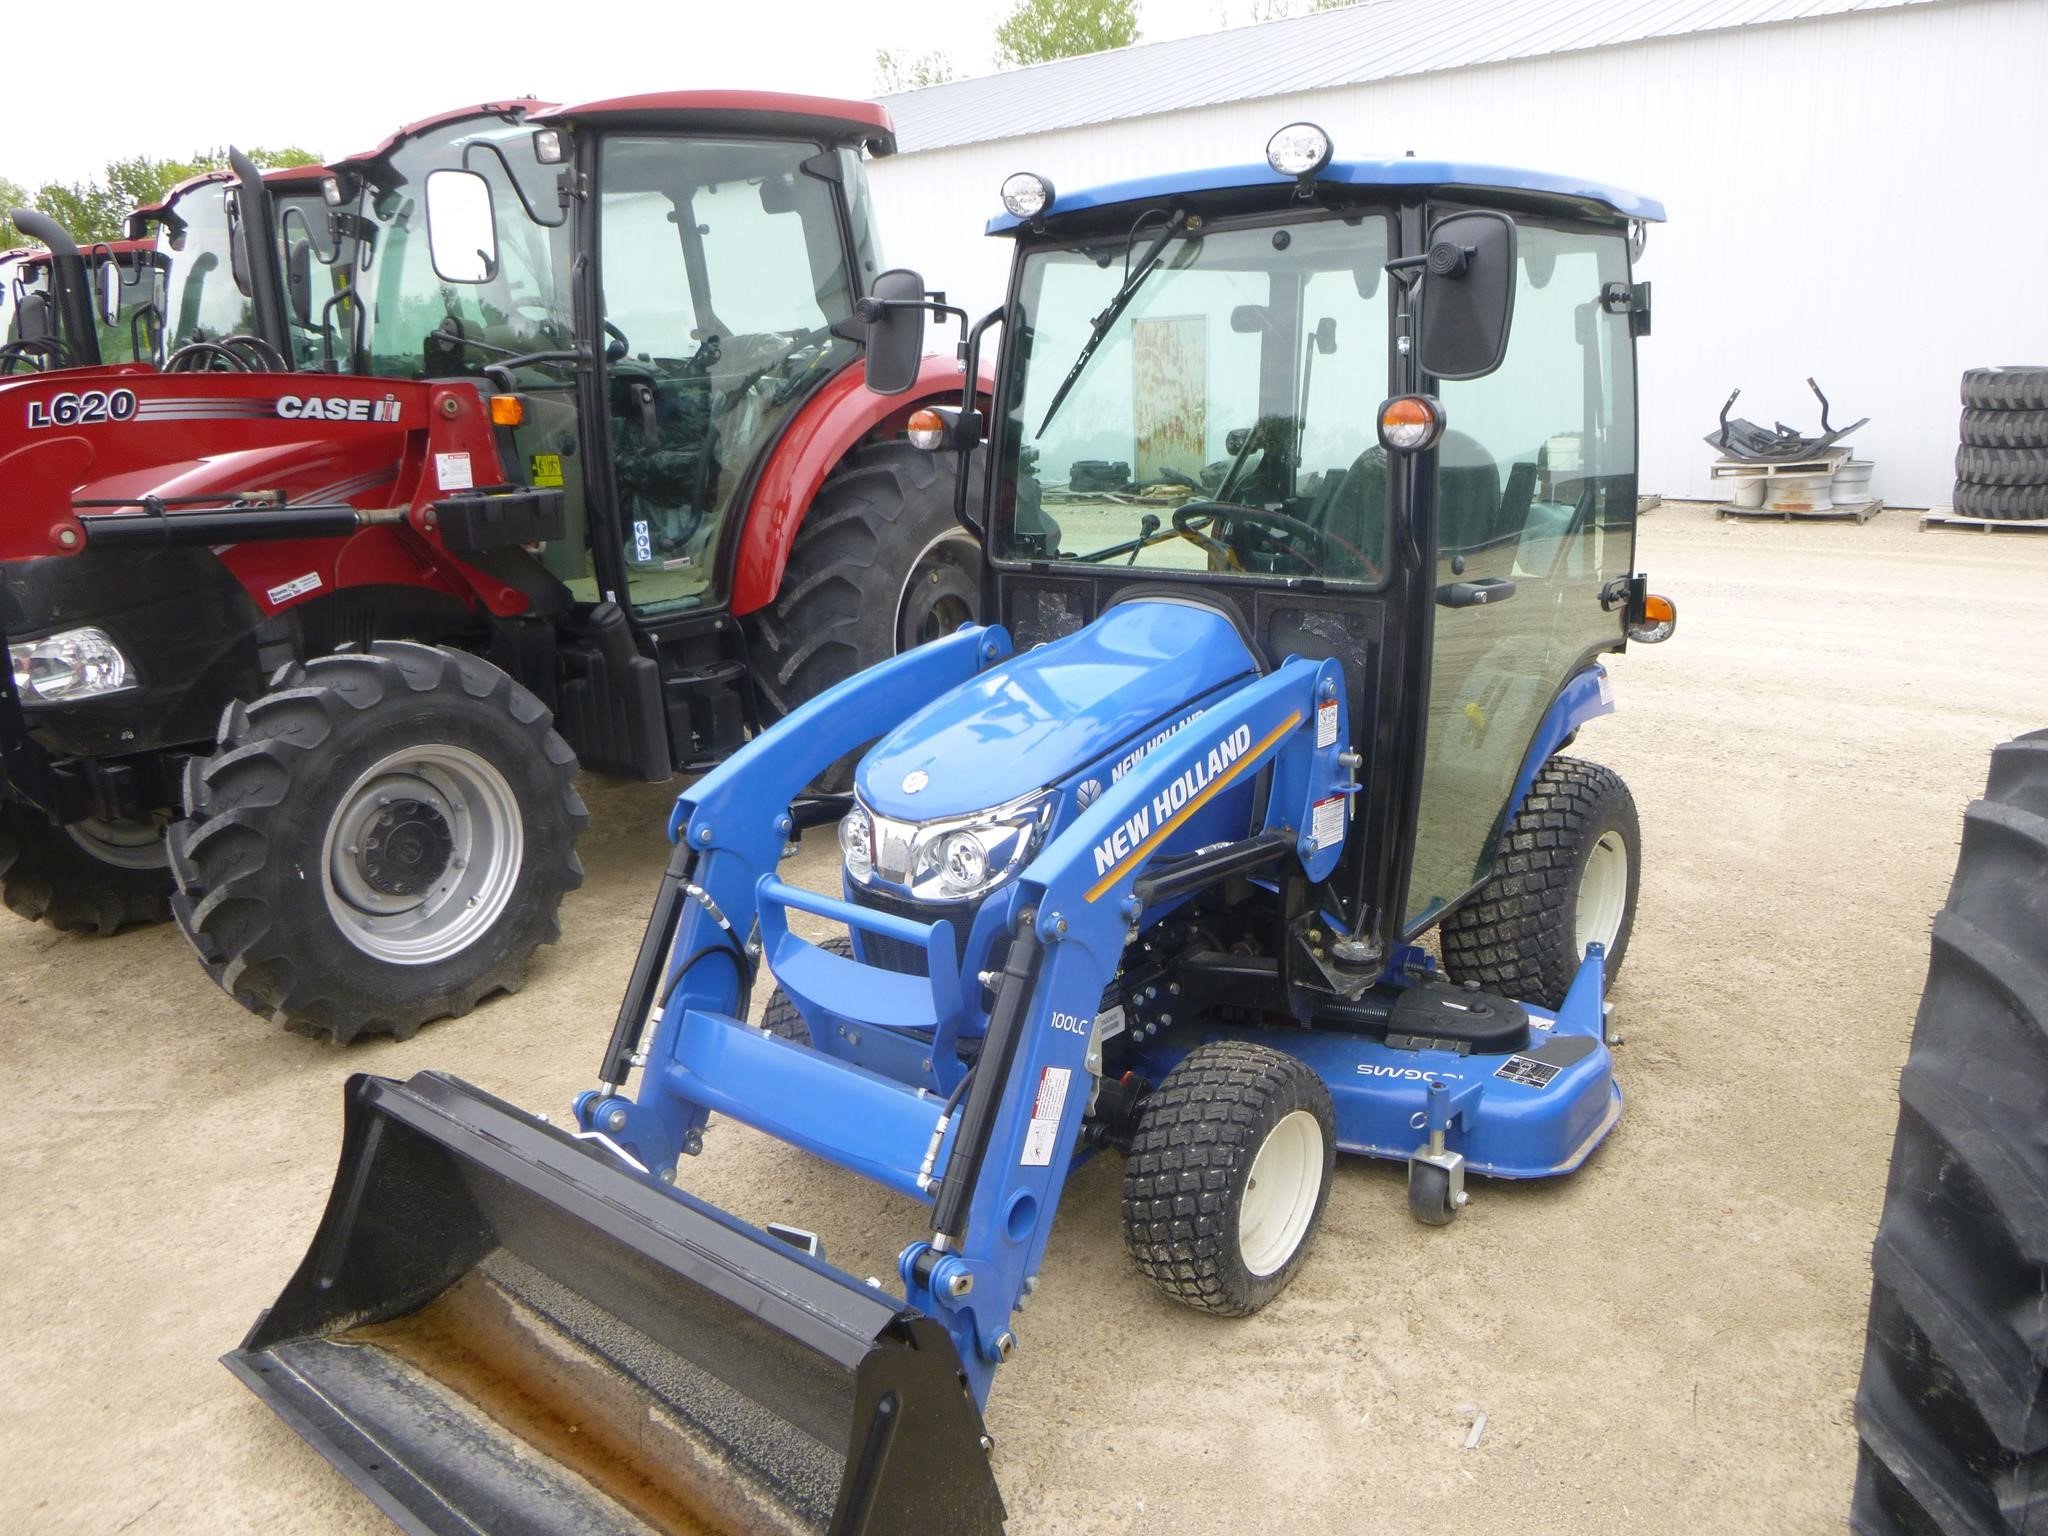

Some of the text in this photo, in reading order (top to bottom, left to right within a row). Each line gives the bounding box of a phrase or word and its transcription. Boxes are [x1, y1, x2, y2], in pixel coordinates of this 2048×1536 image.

[28, 389, 136, 429] L620
[276, 396, 370, 421] CASE
[1111, 746, 1145, 785] NEW
[1093, 806, 1150, 877] NEW
[1153, 724, 1251, 826] HOLLAND
[1051, 1011, 1089, 1036] 100LC
